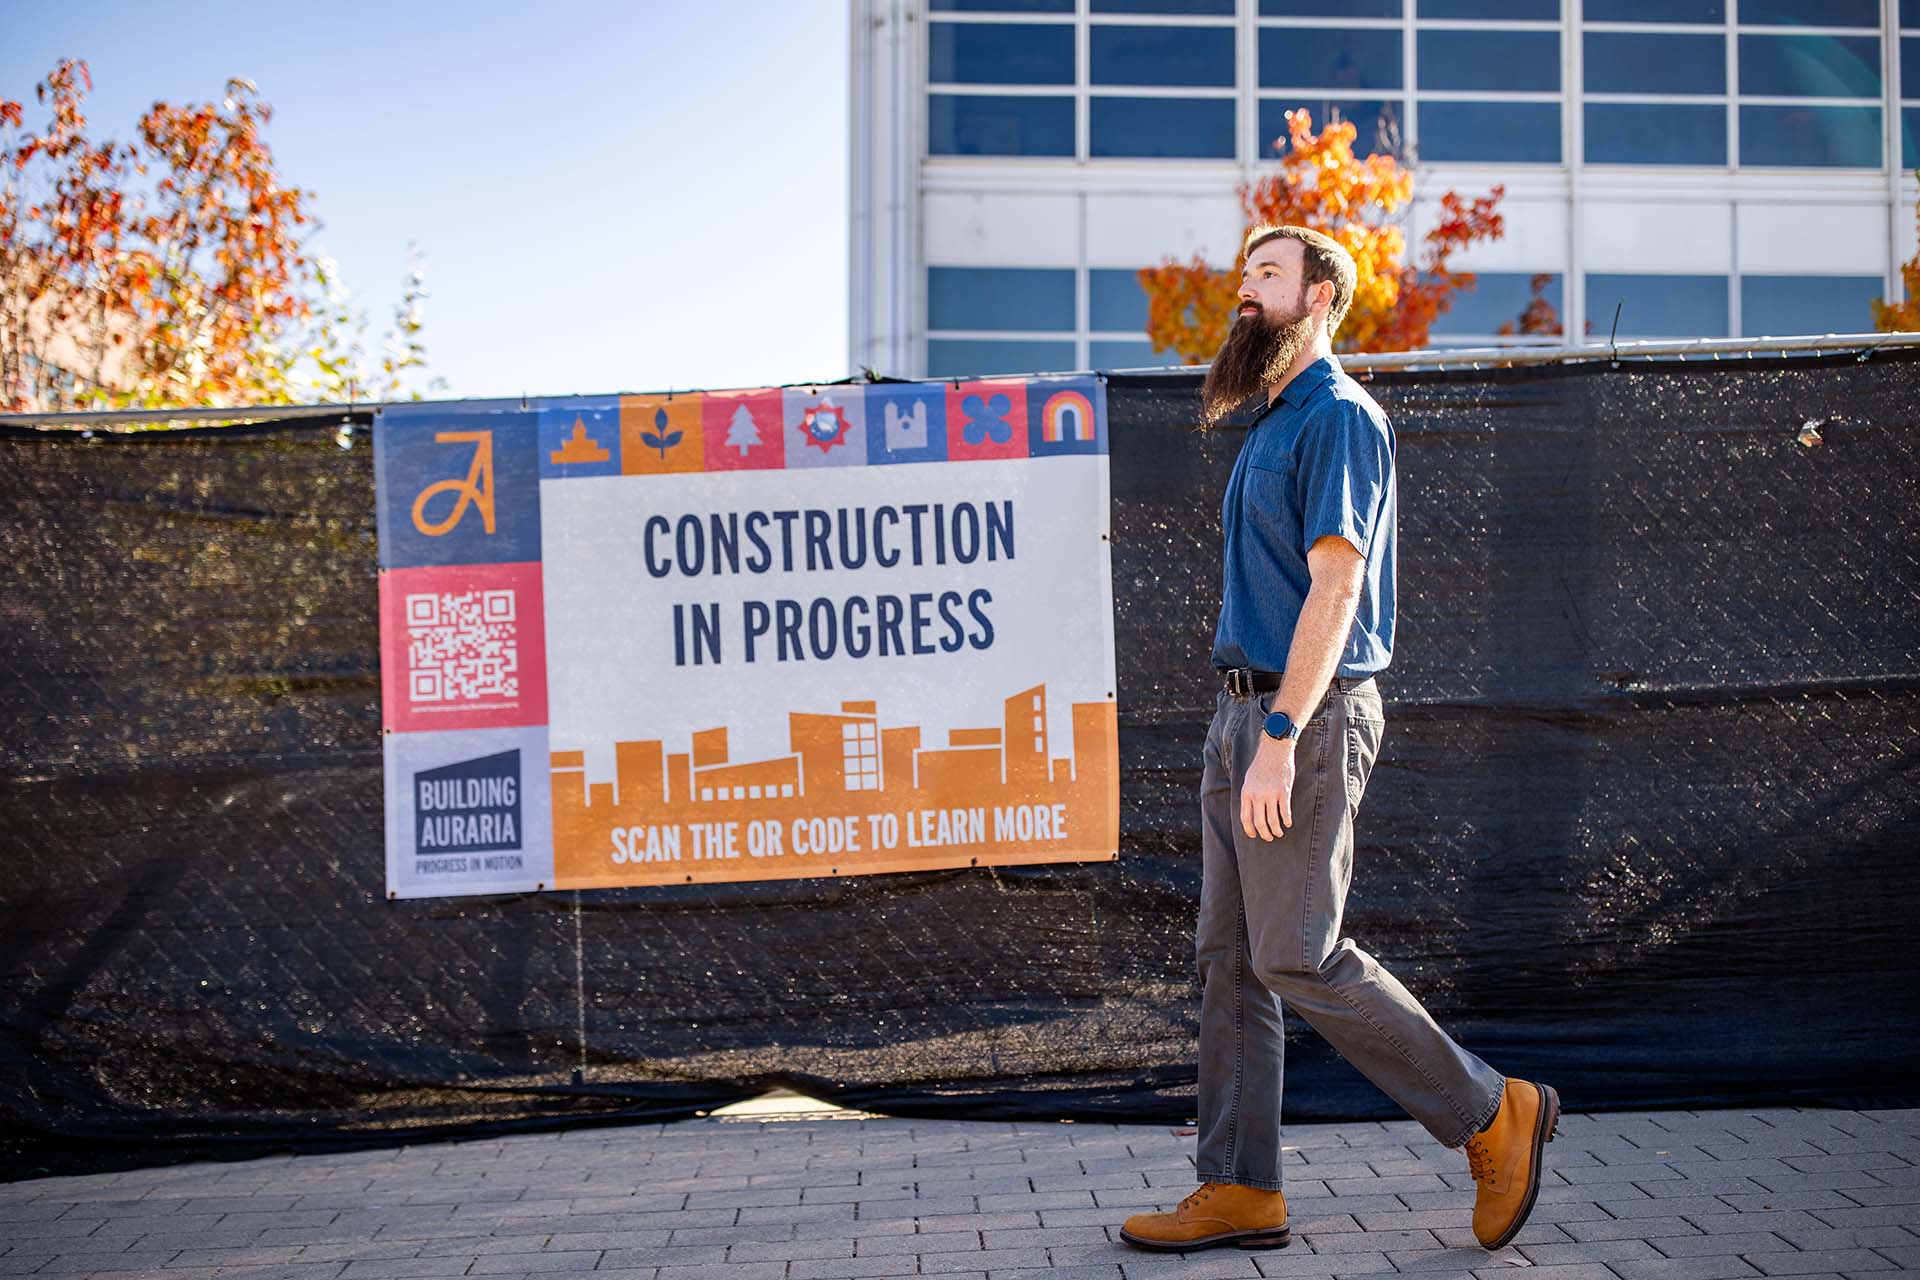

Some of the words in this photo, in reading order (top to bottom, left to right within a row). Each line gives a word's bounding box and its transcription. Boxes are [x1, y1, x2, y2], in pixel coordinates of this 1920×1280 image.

[644, 500, 1015, 578] CONSTRUCTION
[673, 602, 722, 666] IN
[743, 588, 995, 663] PROGRESS
[420, 776, 517, 811] BUILDING
[421, 813, 517, 847] AURARIA
[611, 825, 682, 864] SCAN
[688, 822, 740, 859] THE
[747, 820, 784, 857] QR
[792, 816, 860, 855] CODE
[866, 813, 898, 850] TO
[907, 806, 986, 848] LEARN
[994, 804, 1068, 842] MORE
[416, 858, 467, 874] PROGRESS
[470, 857, 482, 871] IN
[484, 855, 523, 870] MOTION
